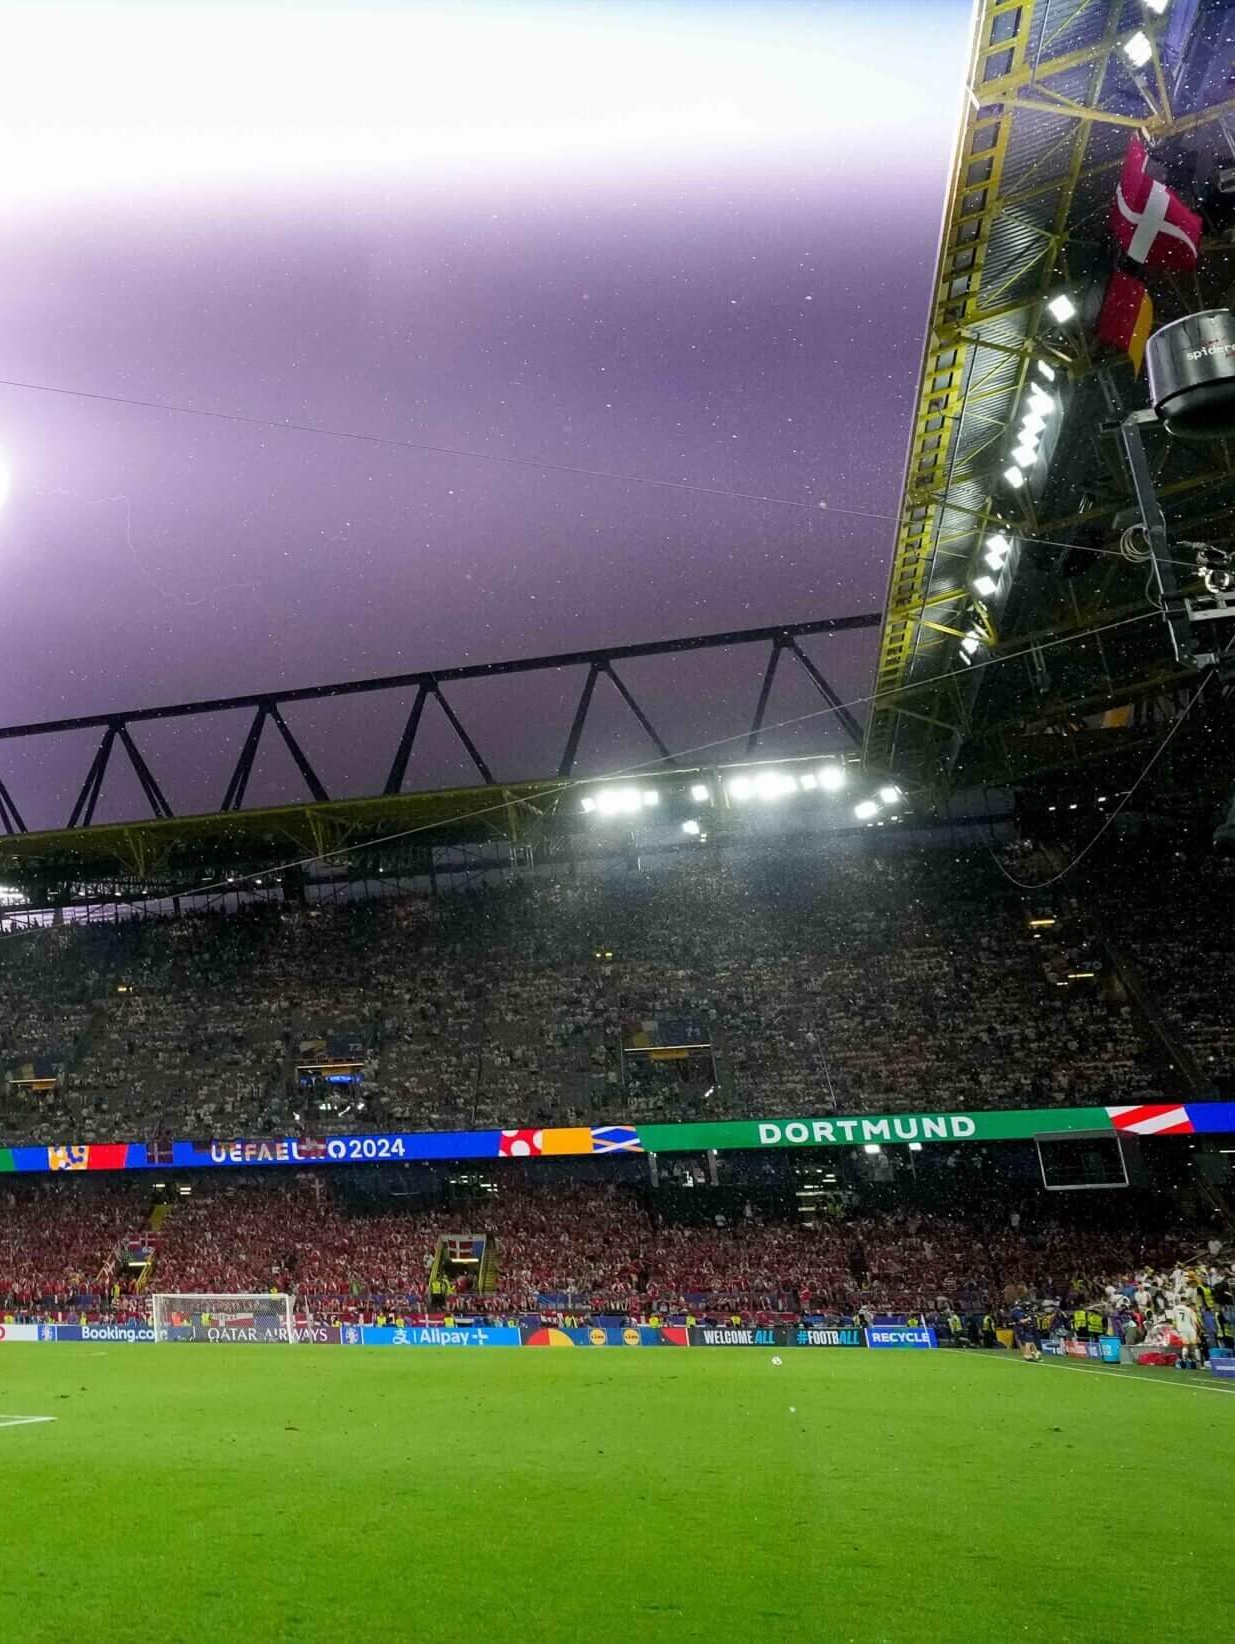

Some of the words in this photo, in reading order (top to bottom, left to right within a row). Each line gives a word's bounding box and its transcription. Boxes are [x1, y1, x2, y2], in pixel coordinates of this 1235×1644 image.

[758, 1116, 977, 1145] DORTMUND
[208, 1327, 257, 1341] QATAR
[703, 1330, 753, 1345] WELCOME
[754, 1330, 775, 1345] ALL
[796, 1330, 860, 1345] #FOOTBALL
[872, 1332, 930, 1343] RECYCLE
